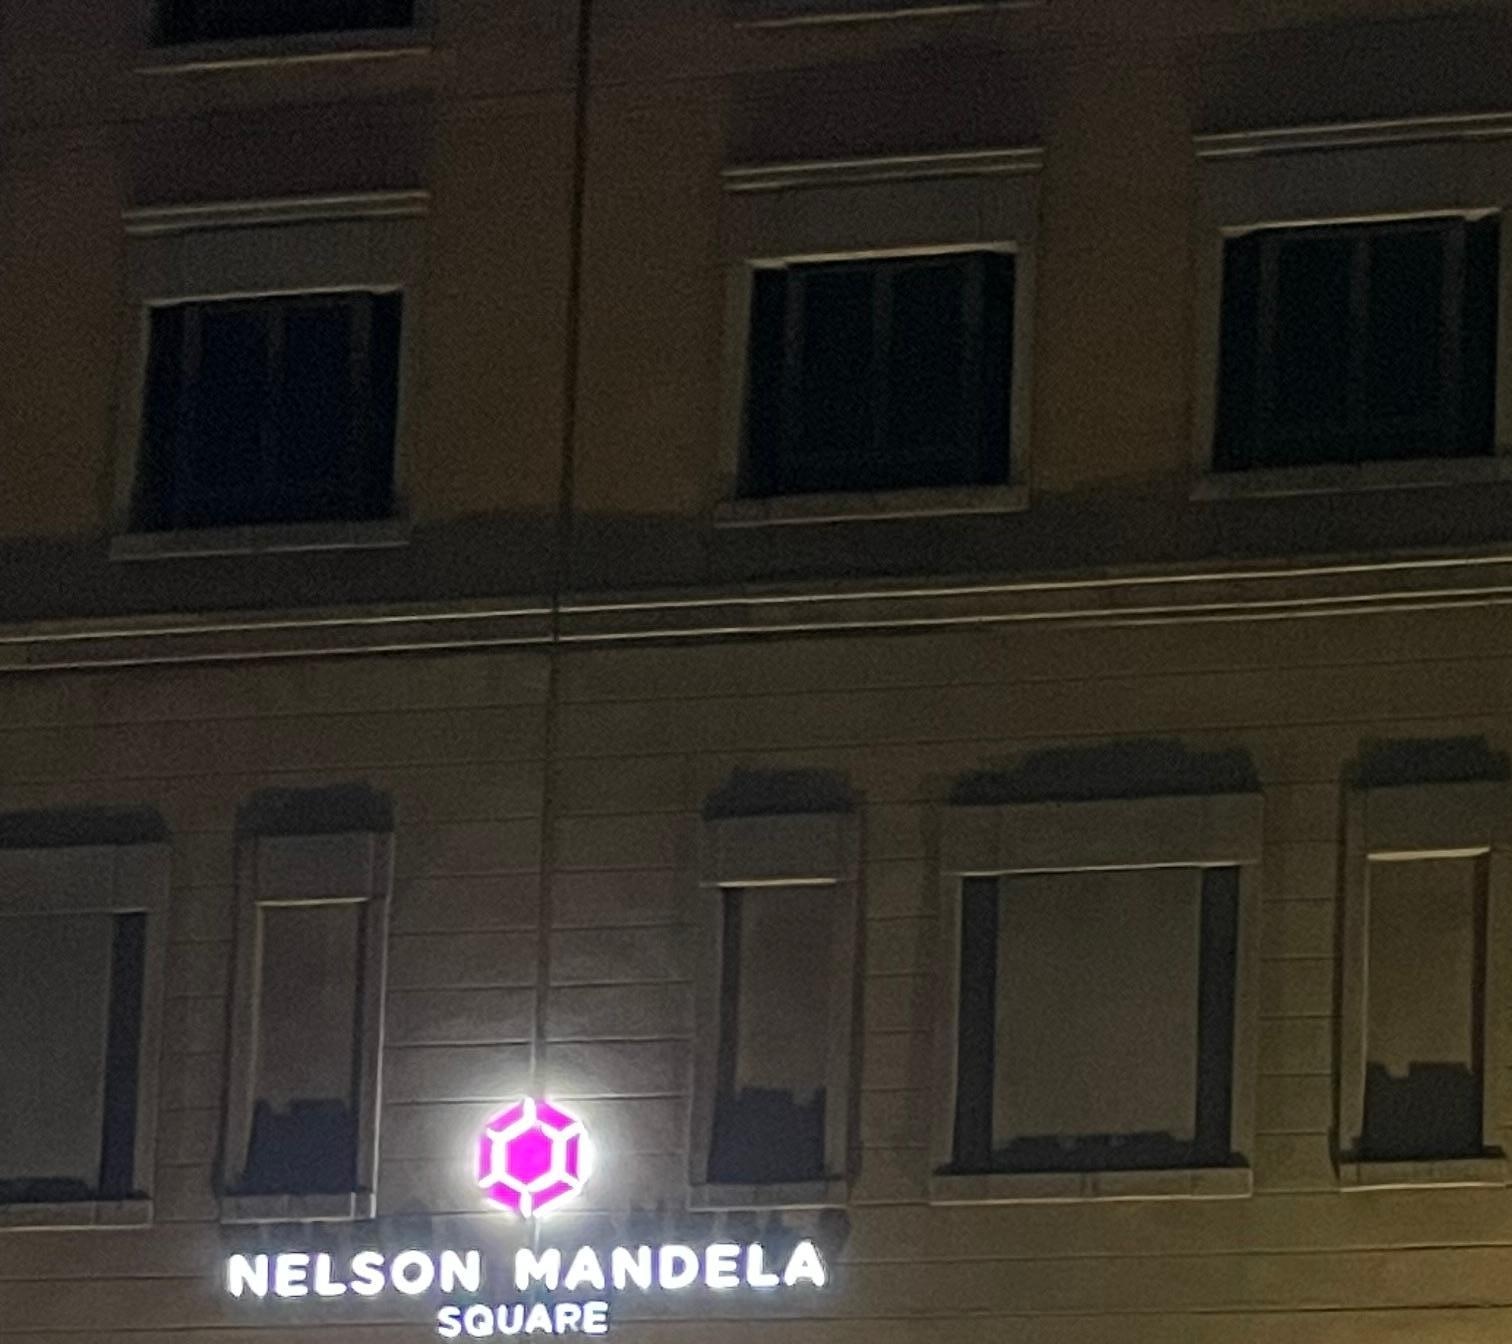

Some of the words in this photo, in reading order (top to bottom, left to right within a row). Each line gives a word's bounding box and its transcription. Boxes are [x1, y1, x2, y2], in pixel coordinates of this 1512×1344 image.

[227, 1249, 481, 1298] NELSON
[513, 1241, 826, 1291] MANDELA
[436, 1300, 609, 1338] SQUARE
